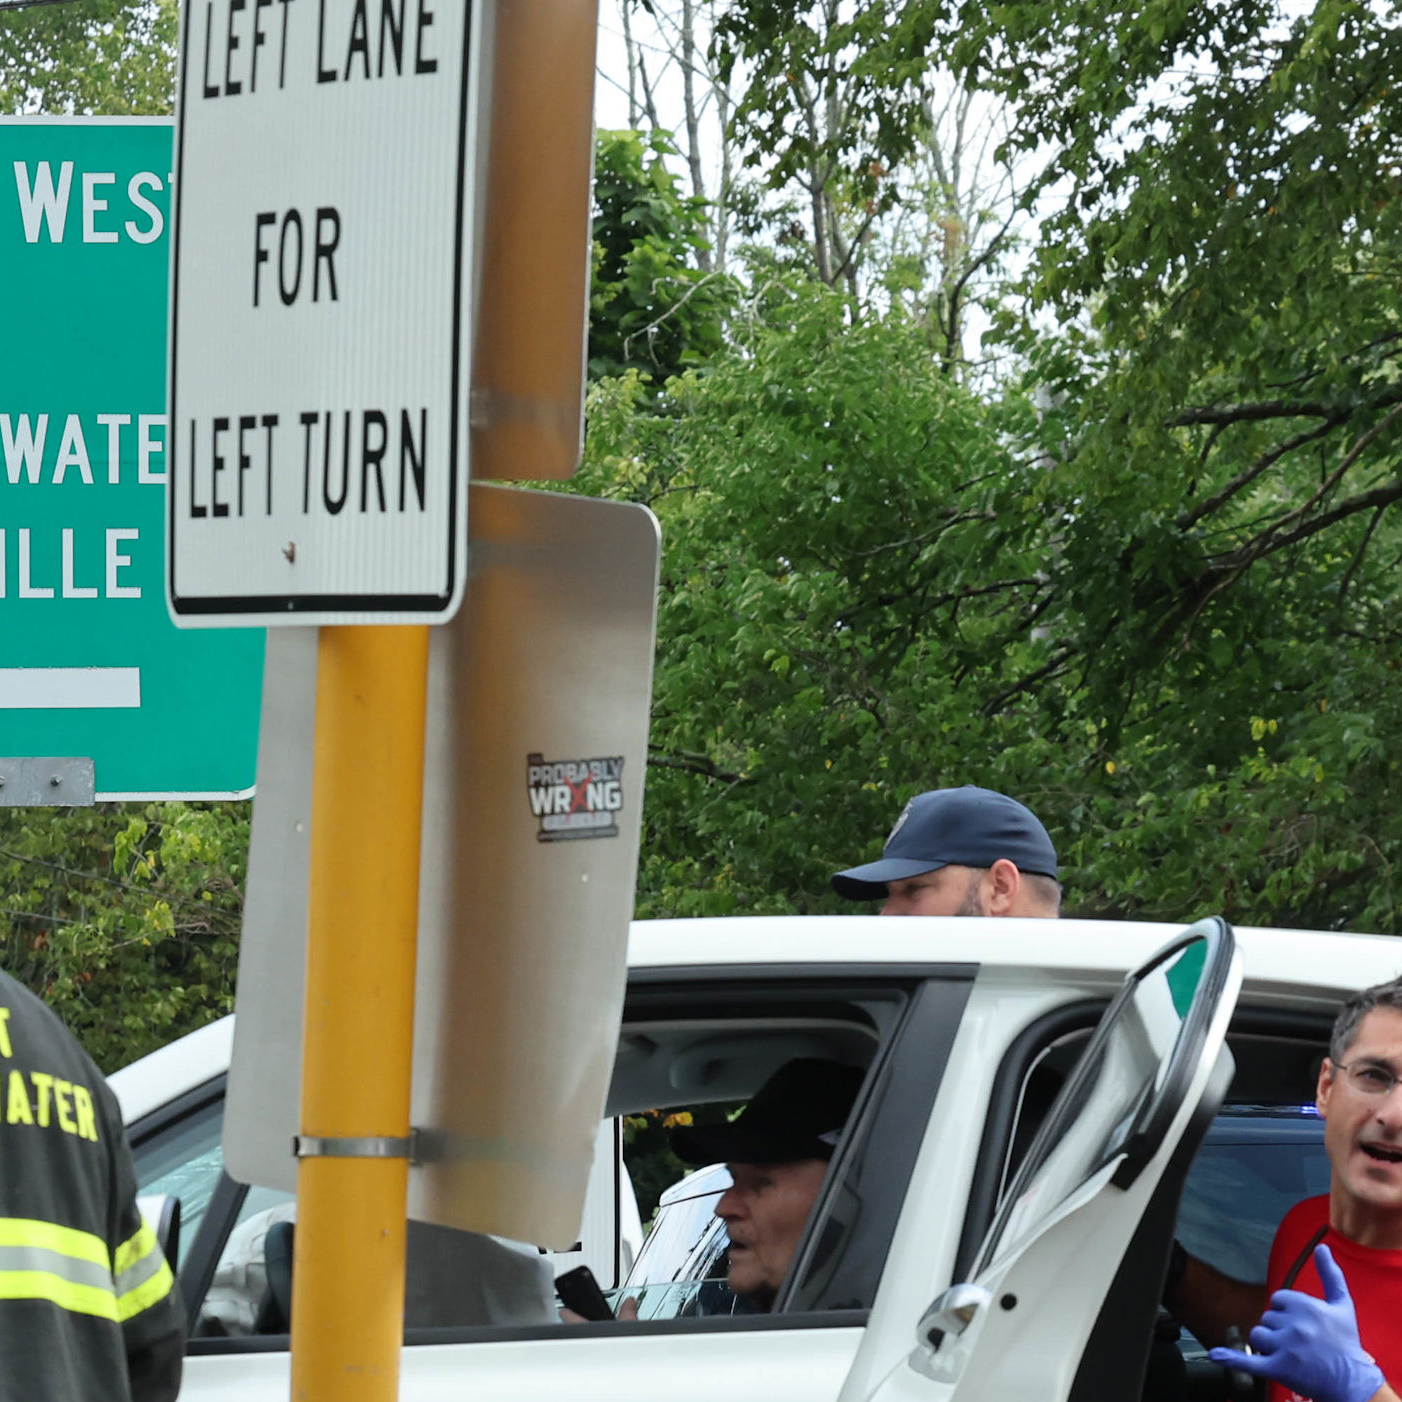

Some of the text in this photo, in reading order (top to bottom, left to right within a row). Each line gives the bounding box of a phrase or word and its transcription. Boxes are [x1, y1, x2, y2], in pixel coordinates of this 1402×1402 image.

[203, 0, 438, 99] LEFT LANE
[13, 160, 174, 244] WES
[253, 206, 341, 307] FOR
[190, 407, 427, 518] LEFT TURN
